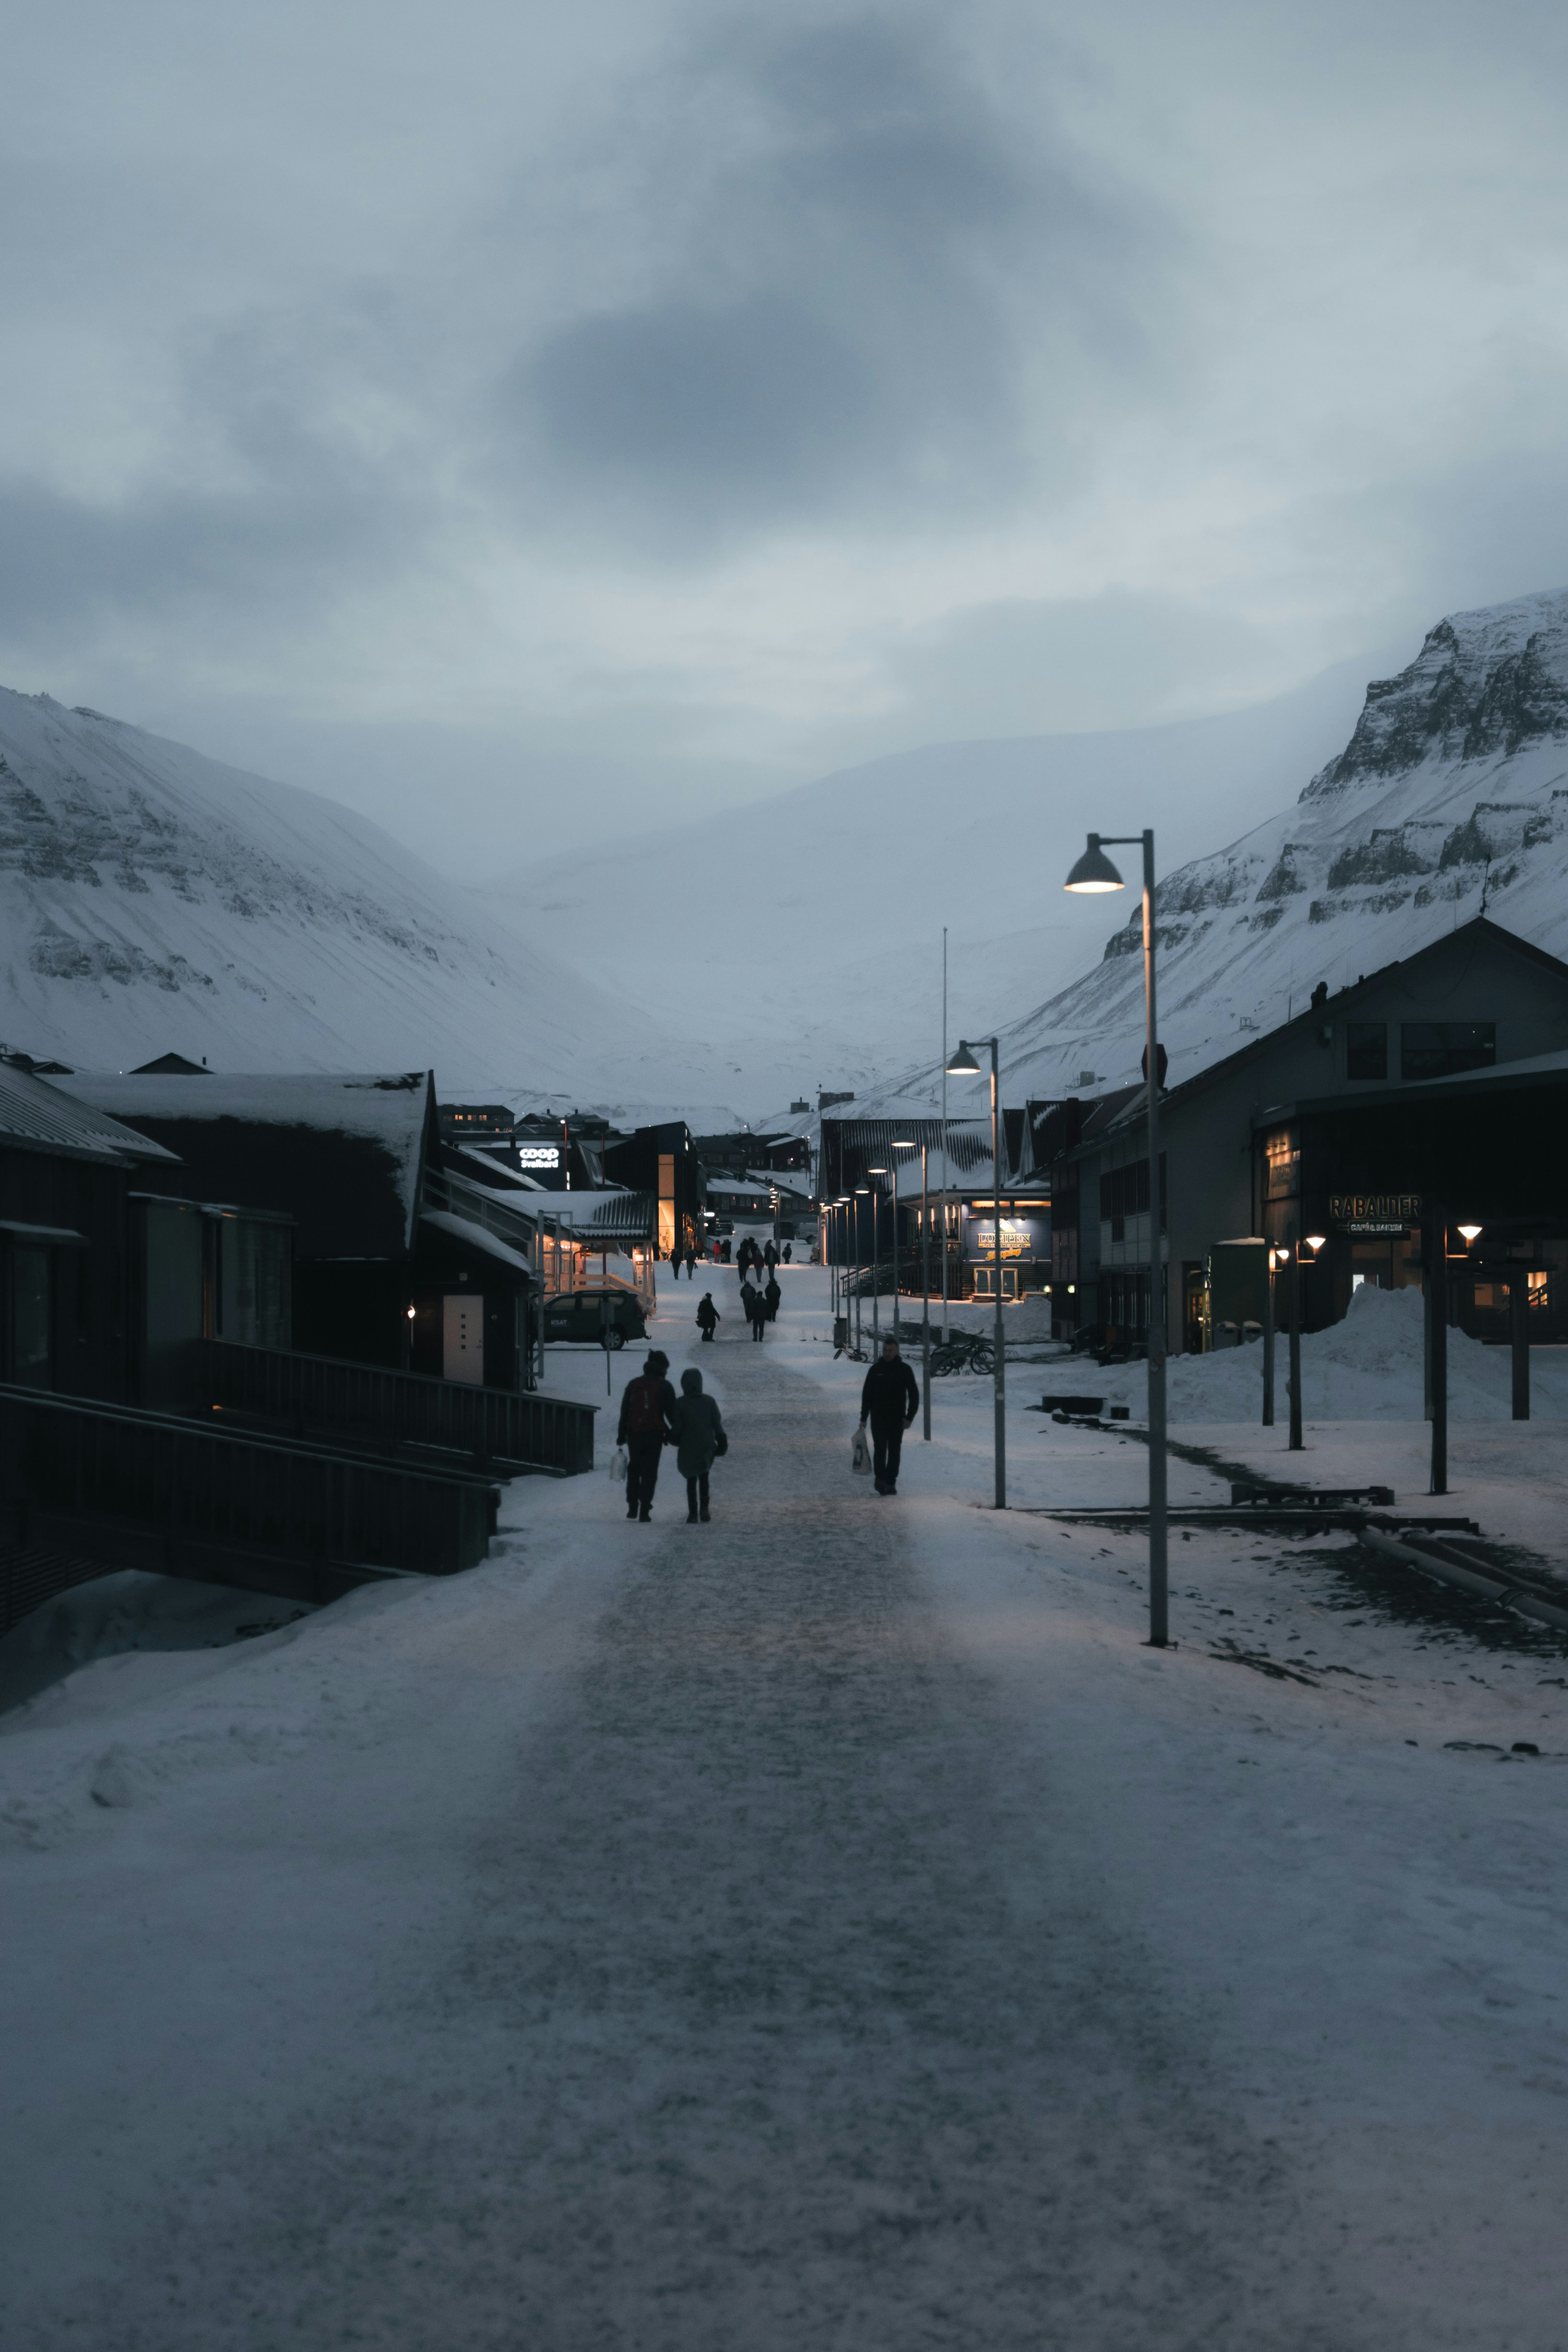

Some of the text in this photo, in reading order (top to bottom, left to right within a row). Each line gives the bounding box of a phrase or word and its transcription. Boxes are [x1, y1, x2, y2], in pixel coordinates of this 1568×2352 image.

[521, 1159, 558, 1168] Svalbard
[1329, 1196, 1421, 1218] RABALDER
[1351, 1222, 1369, 1231] CAFÉ
